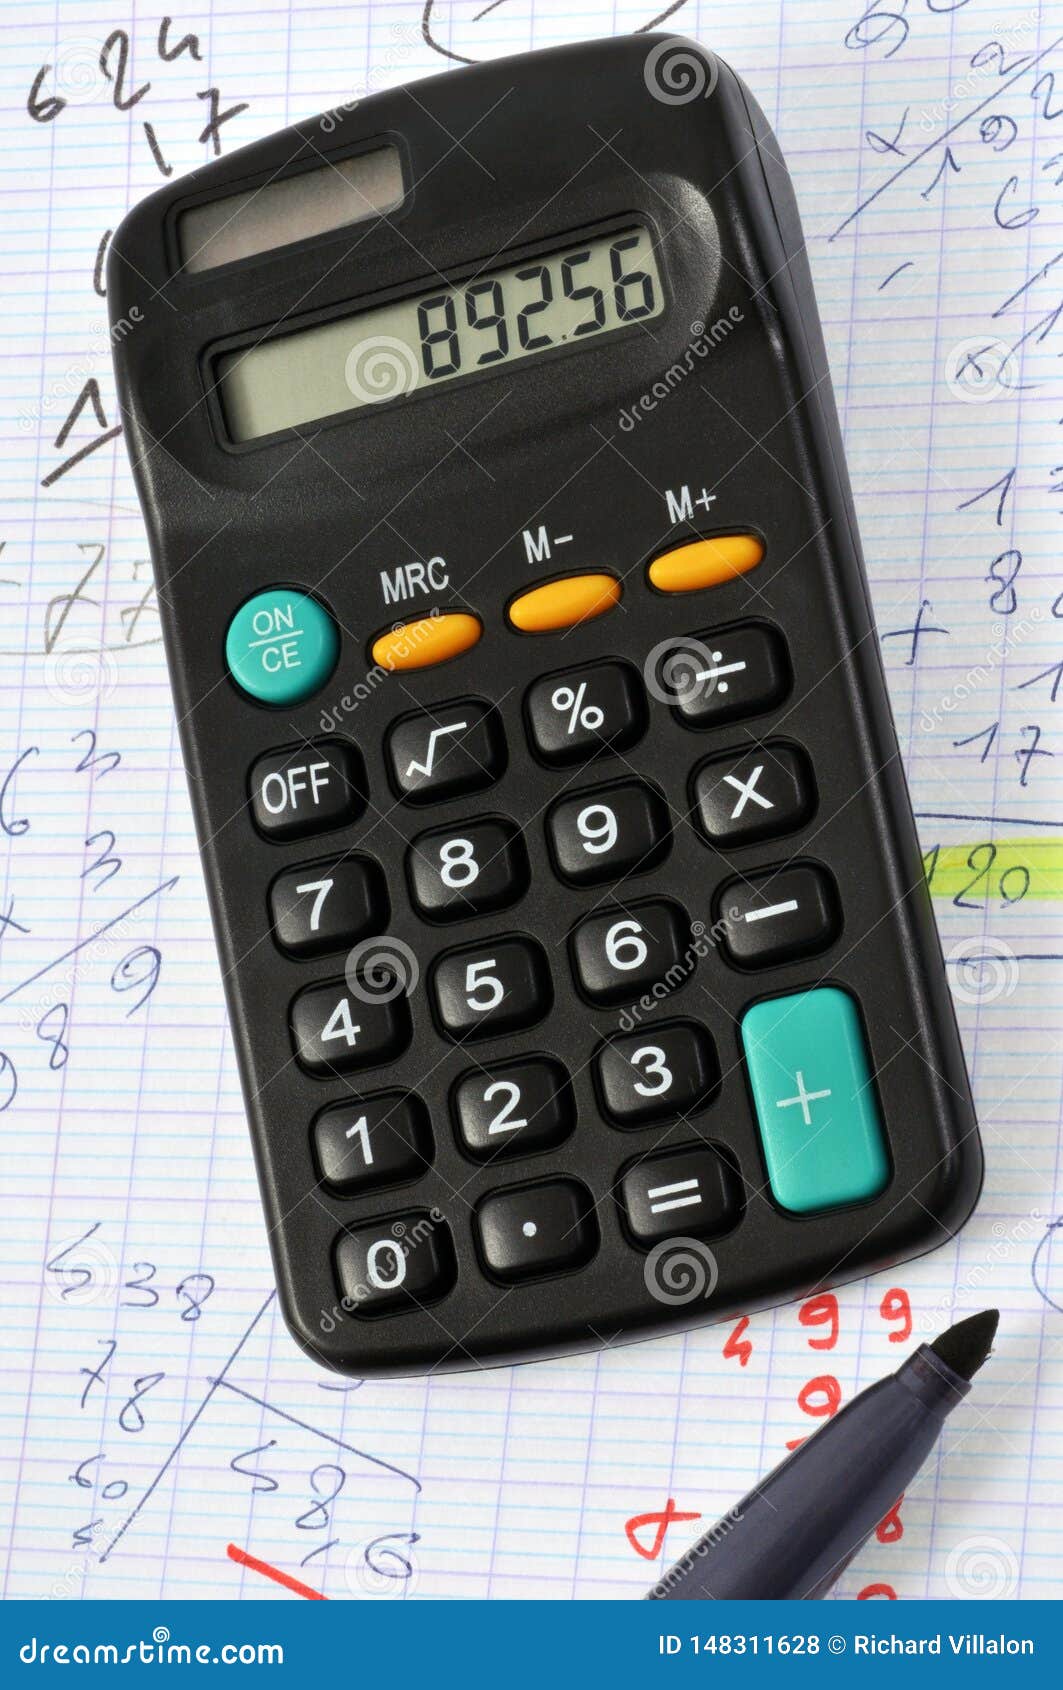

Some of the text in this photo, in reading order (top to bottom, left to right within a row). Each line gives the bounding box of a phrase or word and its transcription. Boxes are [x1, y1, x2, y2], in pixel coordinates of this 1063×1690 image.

[418, 236, 655, 380] 892.56
[666, 486, 716, 524] M+
[523, 526, 573, 563] M-
[381, 556, 449, 604] MRC
[253, 604, 294, 637] ON
[261, 640, 301, 673] CE
[551, 682, 604, 735] %
[261, 761, 330, 815] OFF
[576, 804, 618, 855] 9
[439, 838, 480, 889] 8
[296, 878, 334, 931] 7
[605, 920, 648, 971] 6
[465, 959, 504, 1011] 5
[320, 998, 361, 1047] 4
[631, 1046, 673, 1097] 3
[483, 1081, 528, 1135] 2
[345, 1116, 374, 1165] 1
[367, 1239, 407, 1290] 0
